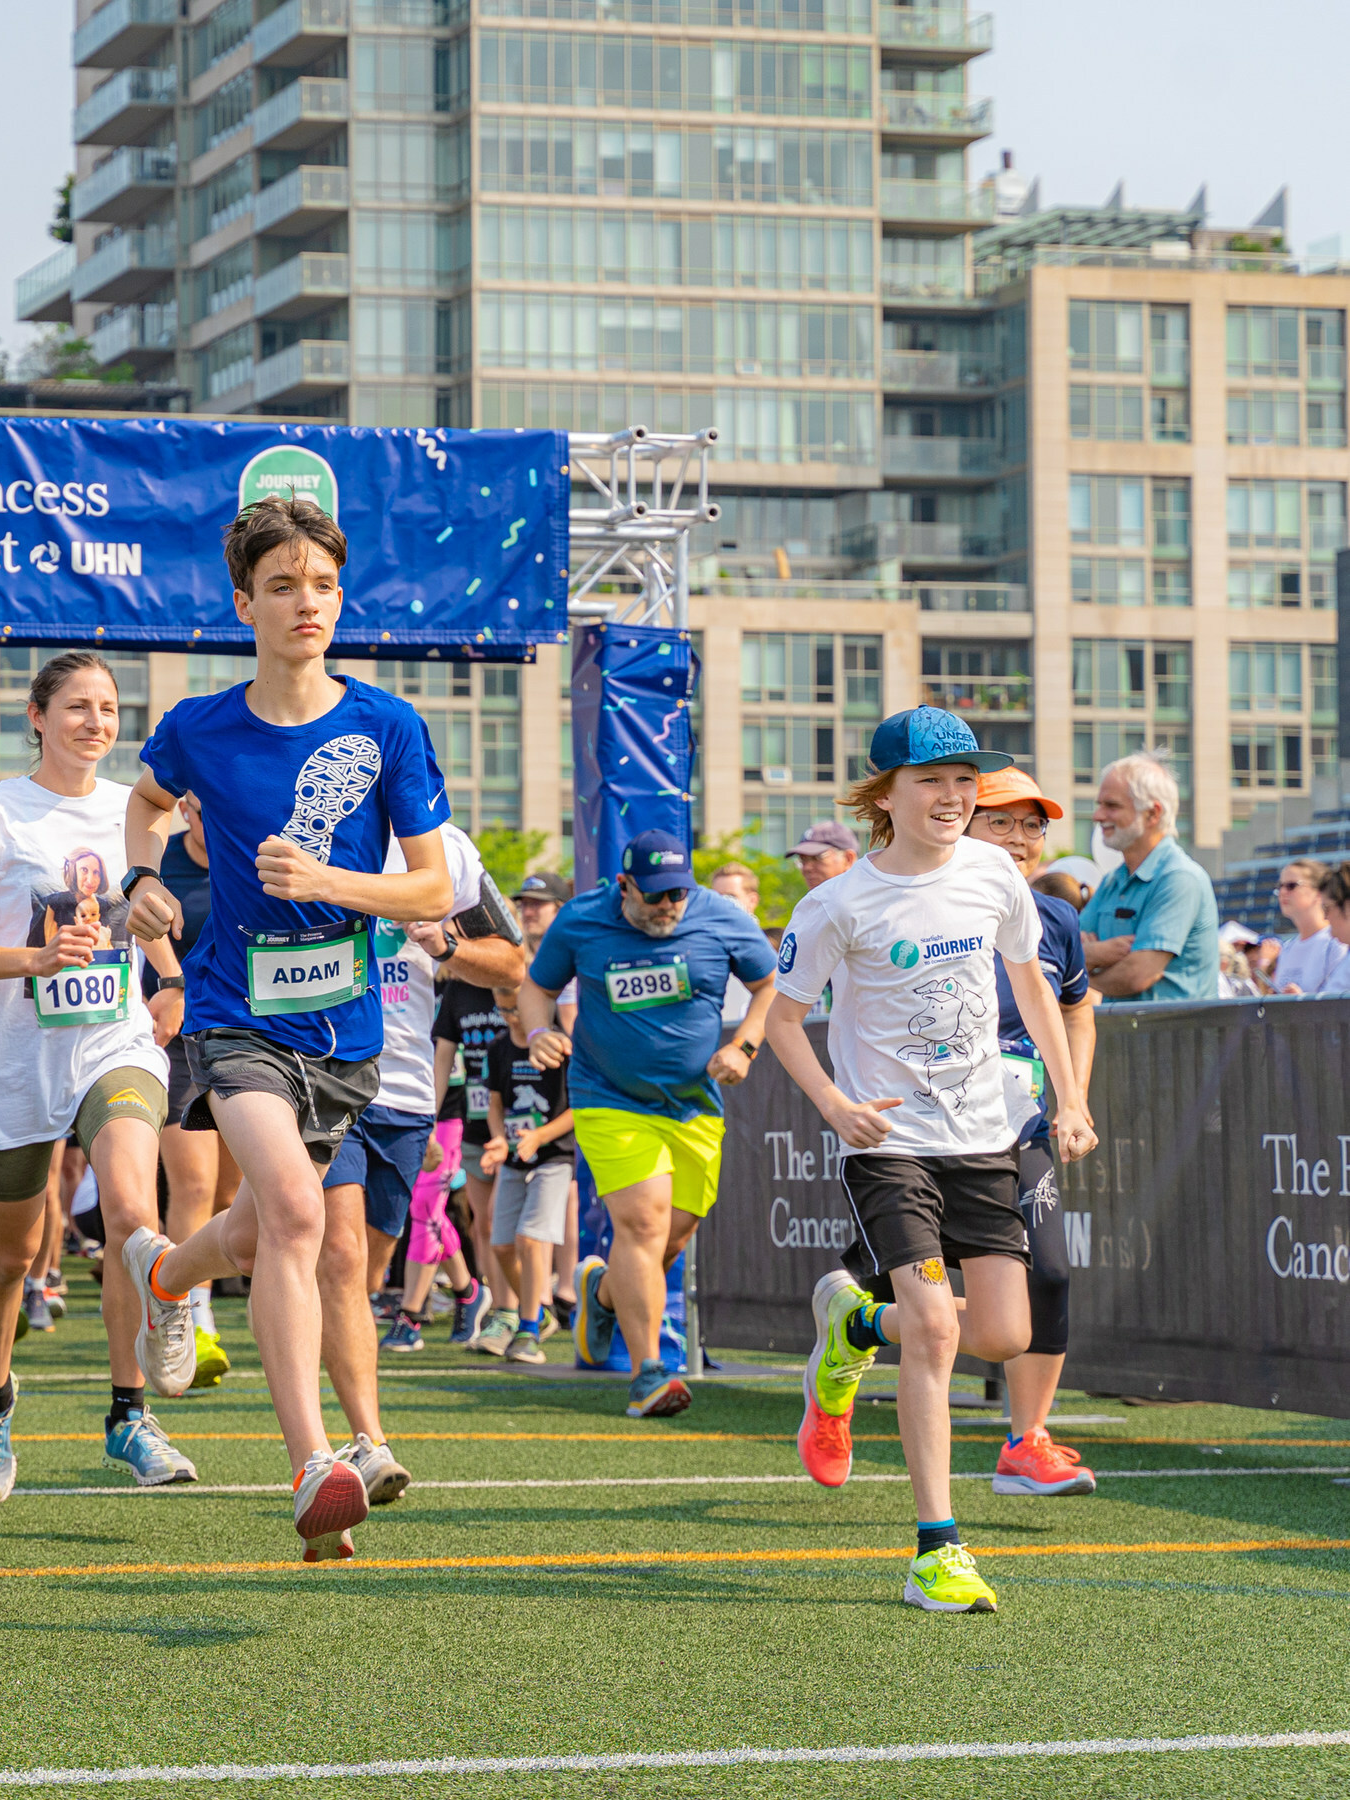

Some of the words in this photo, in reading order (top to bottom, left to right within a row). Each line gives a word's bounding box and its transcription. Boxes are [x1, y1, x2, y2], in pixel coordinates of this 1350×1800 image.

[255, 474, 322, 490] JOURNEY
[71, 541, 142, 577] UHN
[923, 936, 983, 959] JOURNEY
[272, 960, 340, 984] ADAM
[615, 974, 672, 999] 2898
[45, 975, 116, 1009] 1080
[764, 1130, 817, 1182] The
[1261, 1133, 1331, 1197] The
[770, 1197, 849, 1250] Cancer
